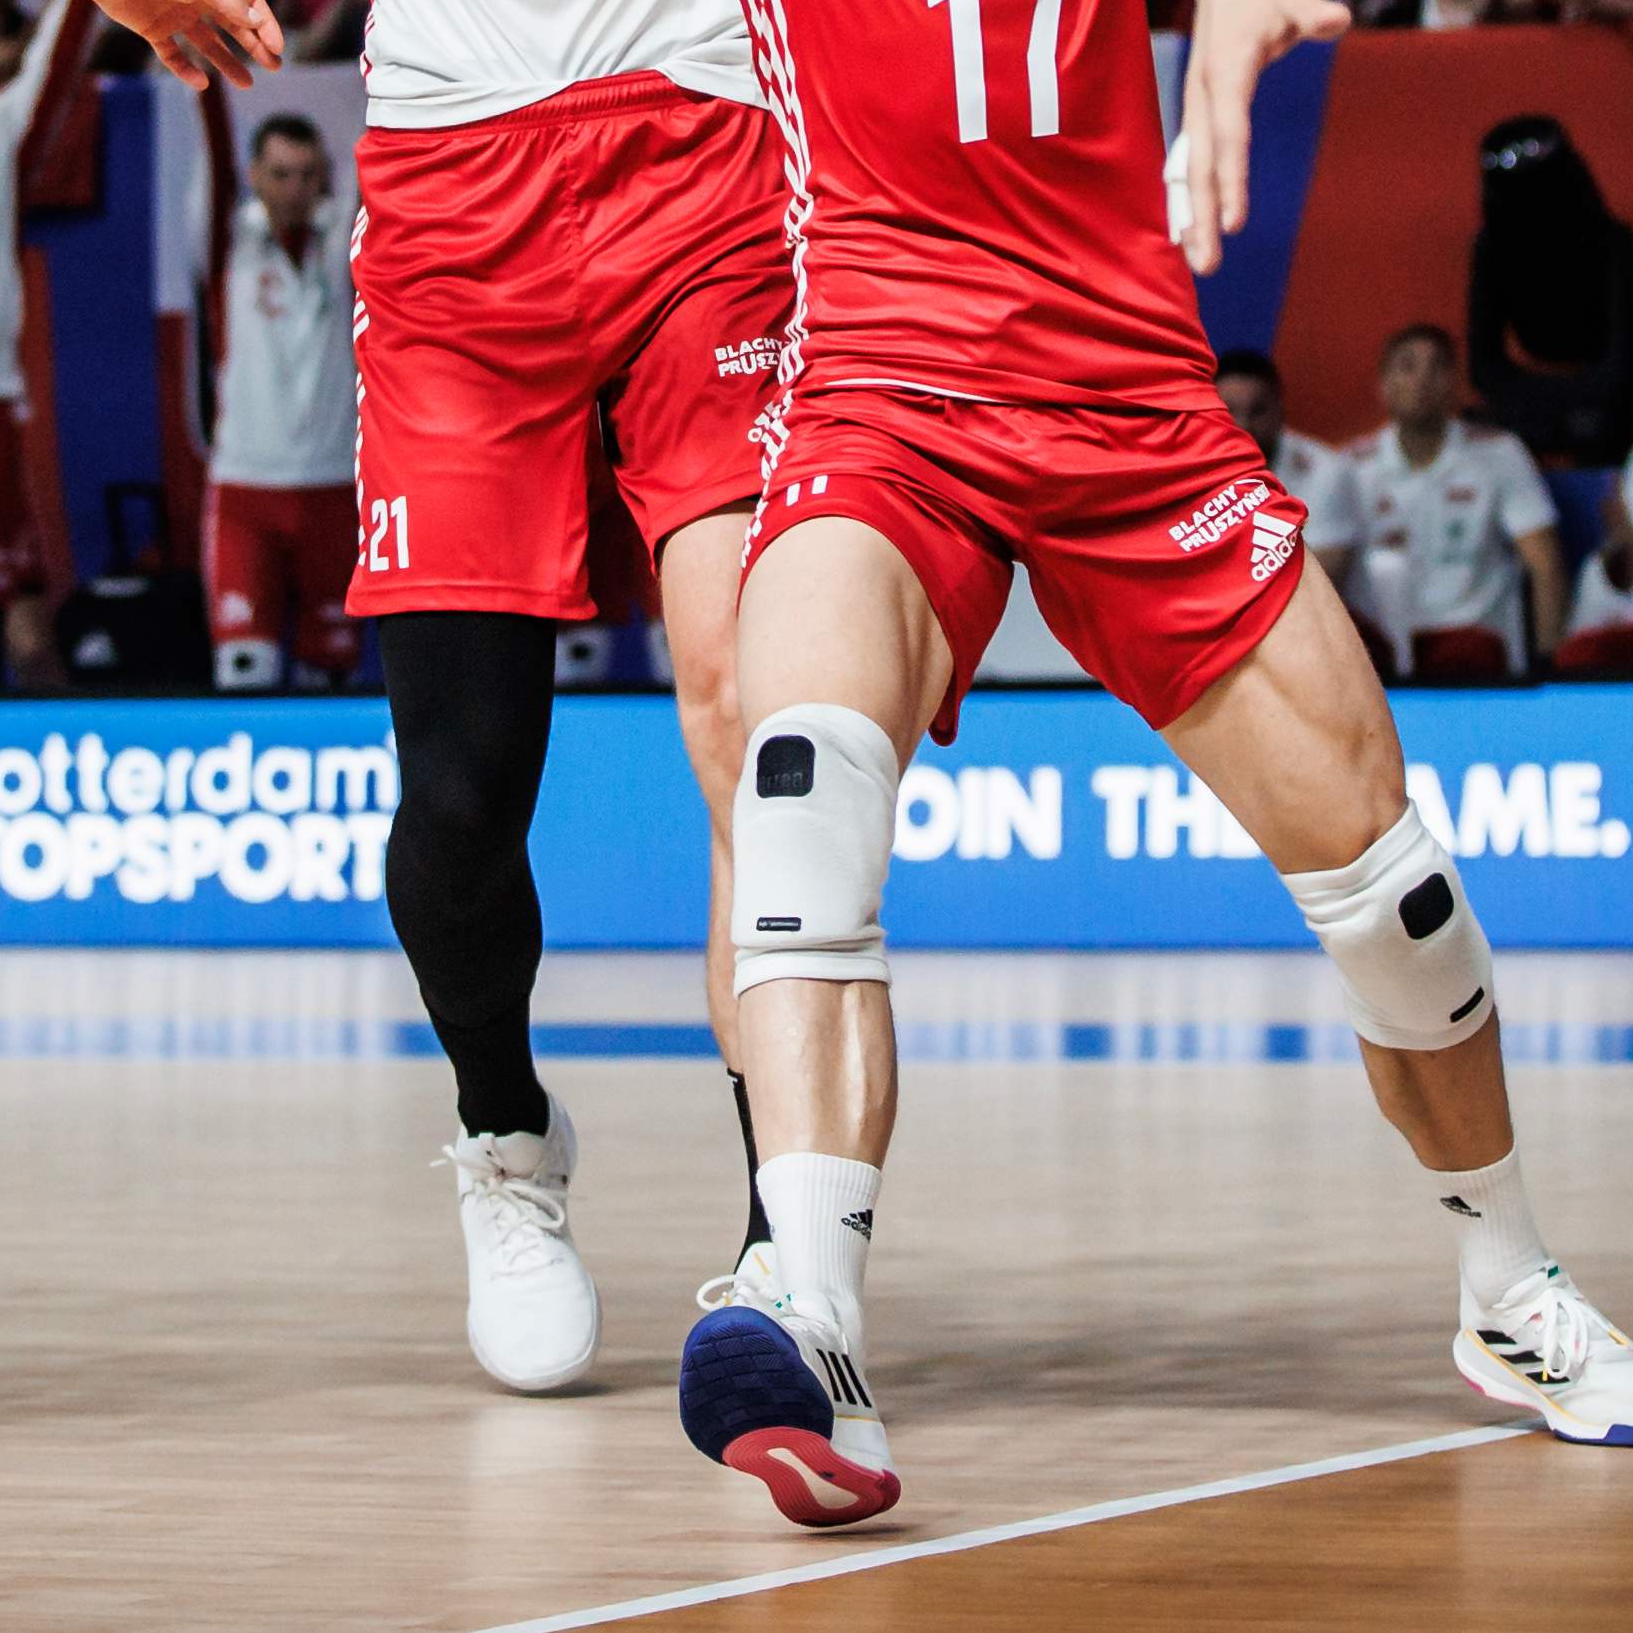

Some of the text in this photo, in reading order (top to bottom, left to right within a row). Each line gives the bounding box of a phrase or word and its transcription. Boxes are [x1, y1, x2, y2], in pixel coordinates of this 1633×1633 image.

[369, 495, 410, 572] 21
[1168, 484, 1238, 541] BLACHY
[892, 765, 1063, 861] OIN
